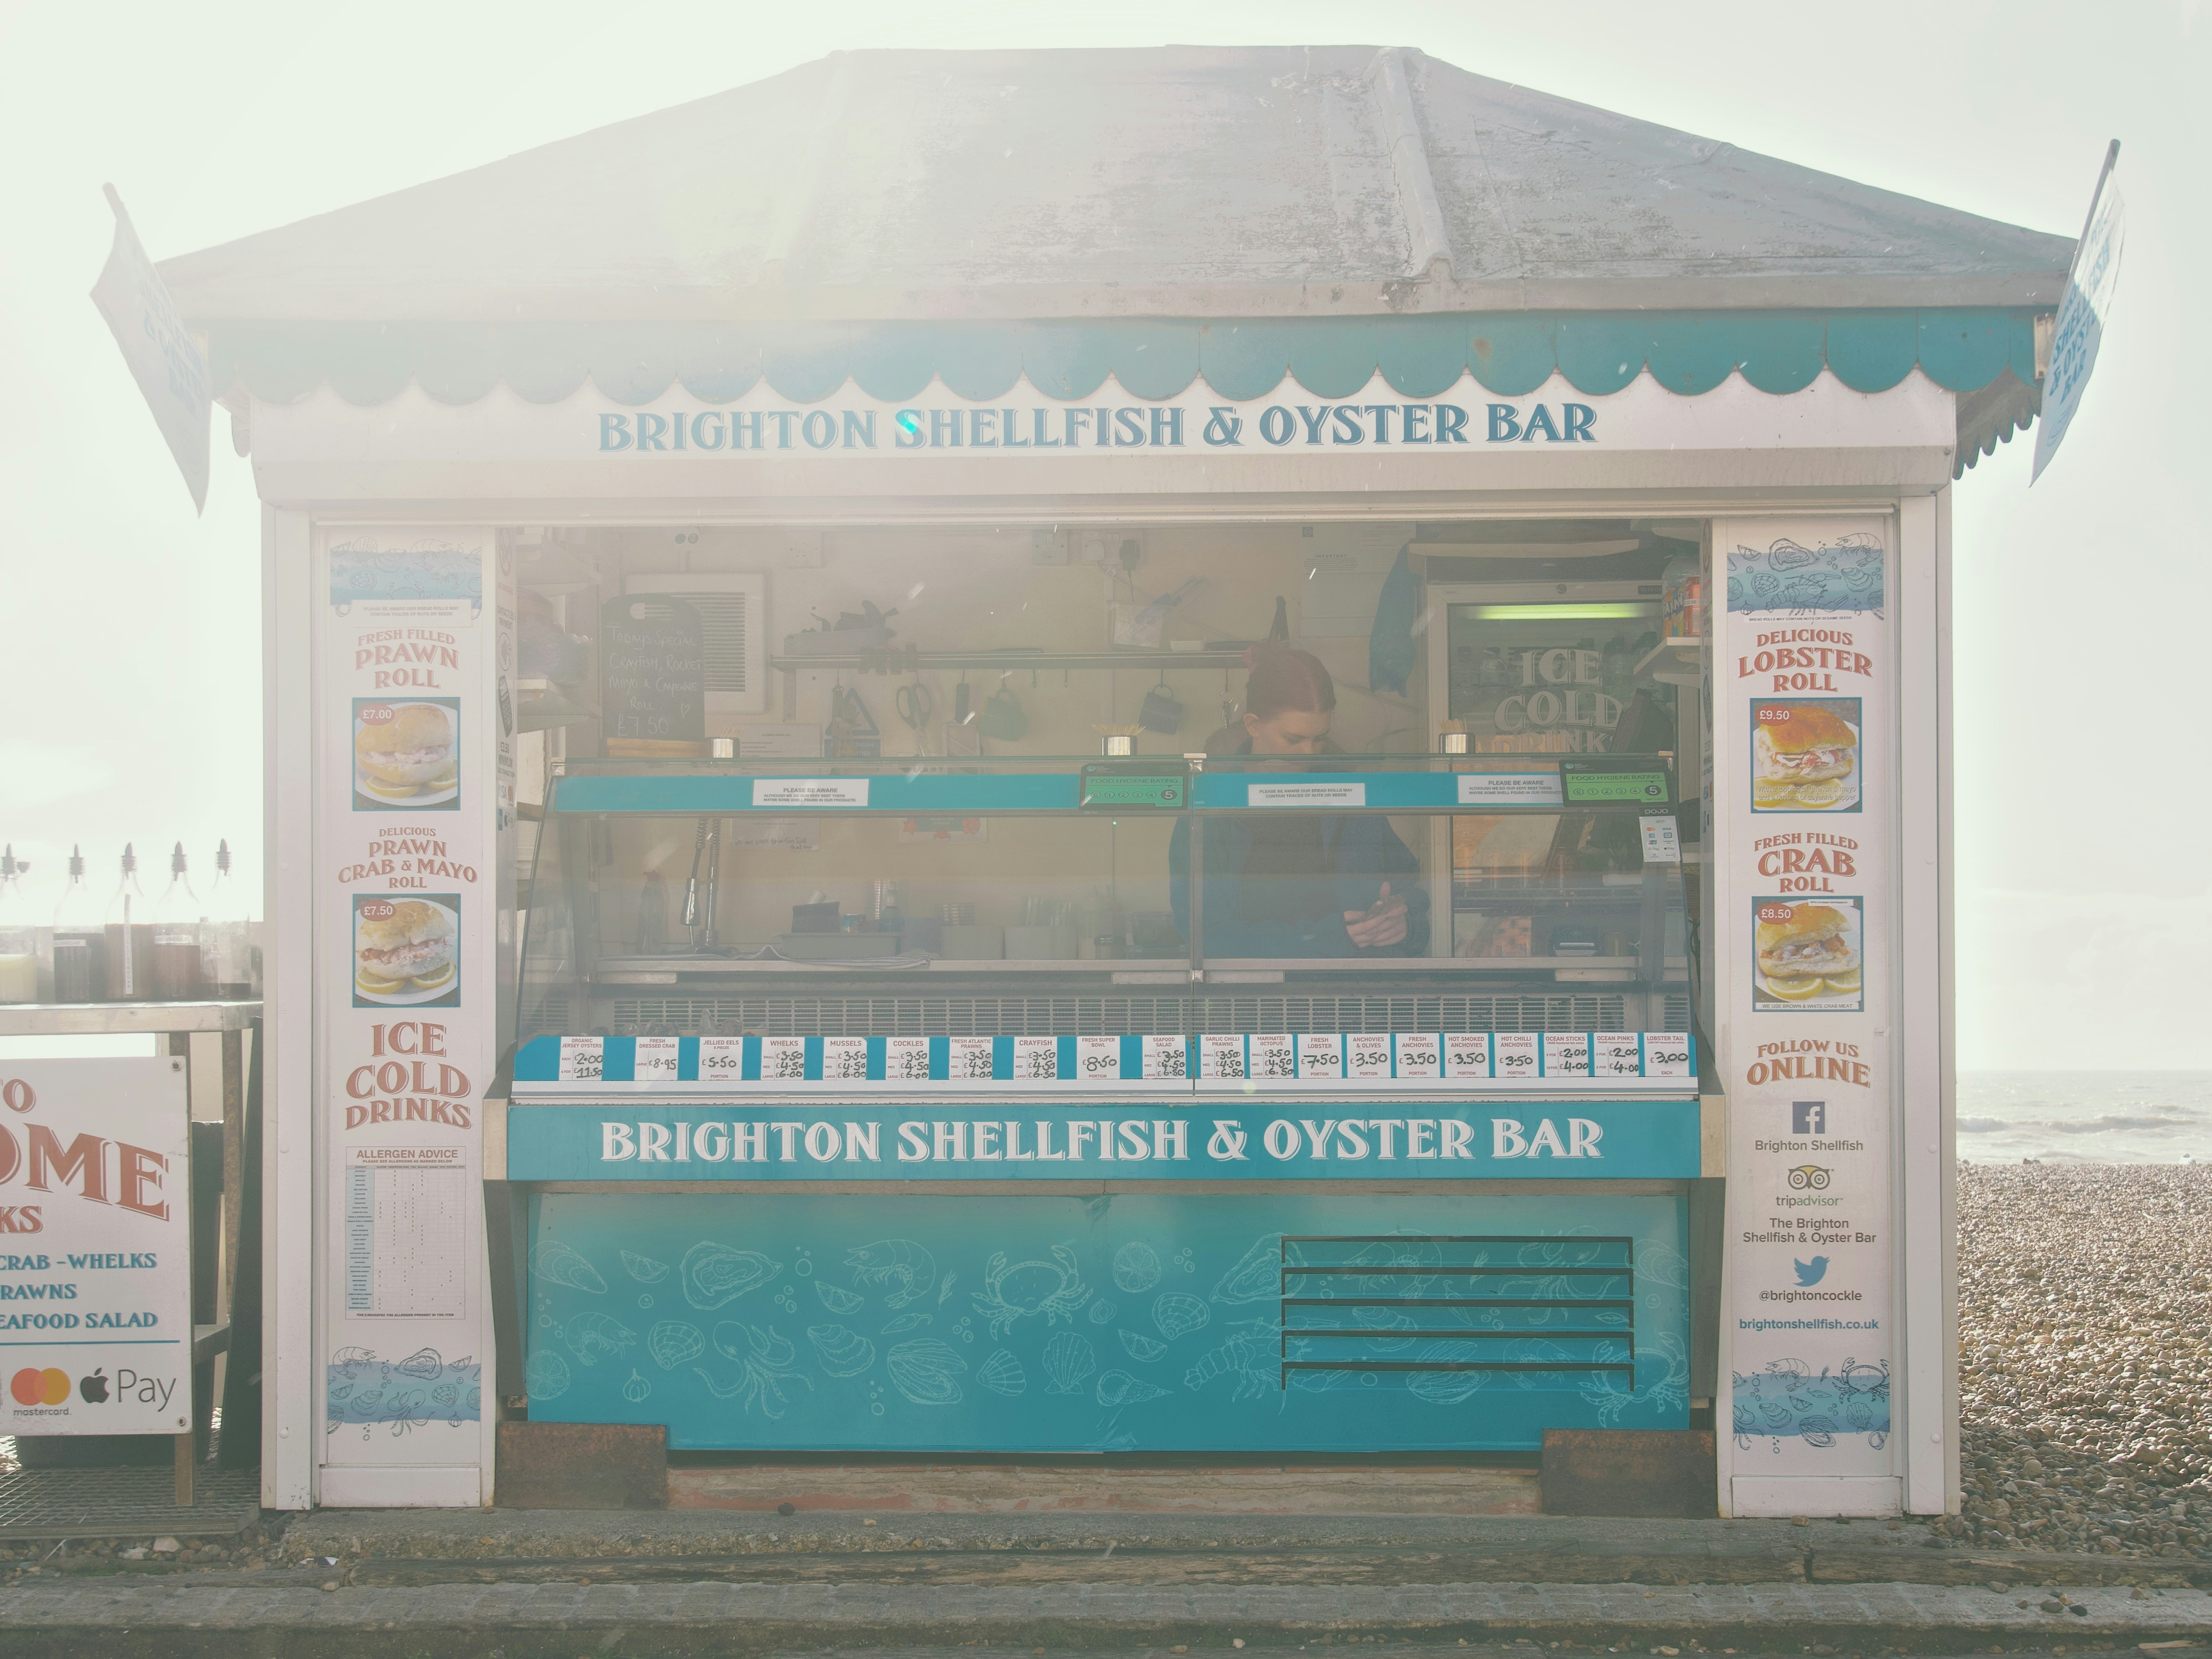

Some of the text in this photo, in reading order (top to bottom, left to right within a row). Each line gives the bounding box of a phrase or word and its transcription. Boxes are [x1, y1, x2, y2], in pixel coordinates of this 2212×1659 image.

[598, 402, 1599, 452] BRIGHTON SHELLFISH & OYSTER BAR
[357, 629, 456, 647] FRESH FILLED
[1756, 629, 1853, 647] DELICIOUS
[355, 643, 459, 670] PRAWN
[1738, 647, 1873, 678] LOBSTER
[1520, 649, 1602, 687] ICE
[374, 668, 441, 689] ROLL
[1772, 673, 1838, 693] ROLL
[363, 709, 392, 720] £7.00
[1494, 690, 1622, 731] COLD
[1759, 711, 1790, 720] £9.50
[1778, 785, 1800, 793] topping
[1810, 785, 1831, 793] gherkin
[379, 827, 436, 837] DELICIOUS
[369, 839, 447, 858] PRAWN
[1754, 832, 1858, 852] FRESH FILLED
[338, 858, 478, 883] CRAB & MAYO
[1757, 848, 1856, 877] CRAB
[389, 876, 427, 889] ROLL
[1779, 876, 1834, 893] ROLL
[364, 905, 393, 916] £7.50
[1761, 909, 1791, 918] £8.50
[371, 1022, 447, 1057] ICE
[1757, 1040, 1859, 1058] FOLLOW US
[346, 1061, 471, 1100] COLD
[1747, 1055, 1870, 1088] ONLINE
[0, 1078, 36, 1113] O
[345, 1098, 472, 1131] DRINKS
[600, 1118, 1604, 1163] BRIGHTON SHELLFISH & OYSTER BAR
[1755, 1140, 1863, 1153] Brighton Shellfish
[357, 1149, 458, 1158] ALLERGEN ADVICE
[1776, 1195, 1839, 1208] tripadvisor
[1770, 1218, 1849, 1230] The Brighton
[1743, 1232, 1876, 1245] Shellfish & Oyster Bar
[1759, 1290, 1862, 1302] @brightoncockle
[85, 1312, 159, 1328] SALAD
[1739, 1319, 1879, 1331] brightonshellfish.co.uk
[119, 1369, 177, 1412] Pay
